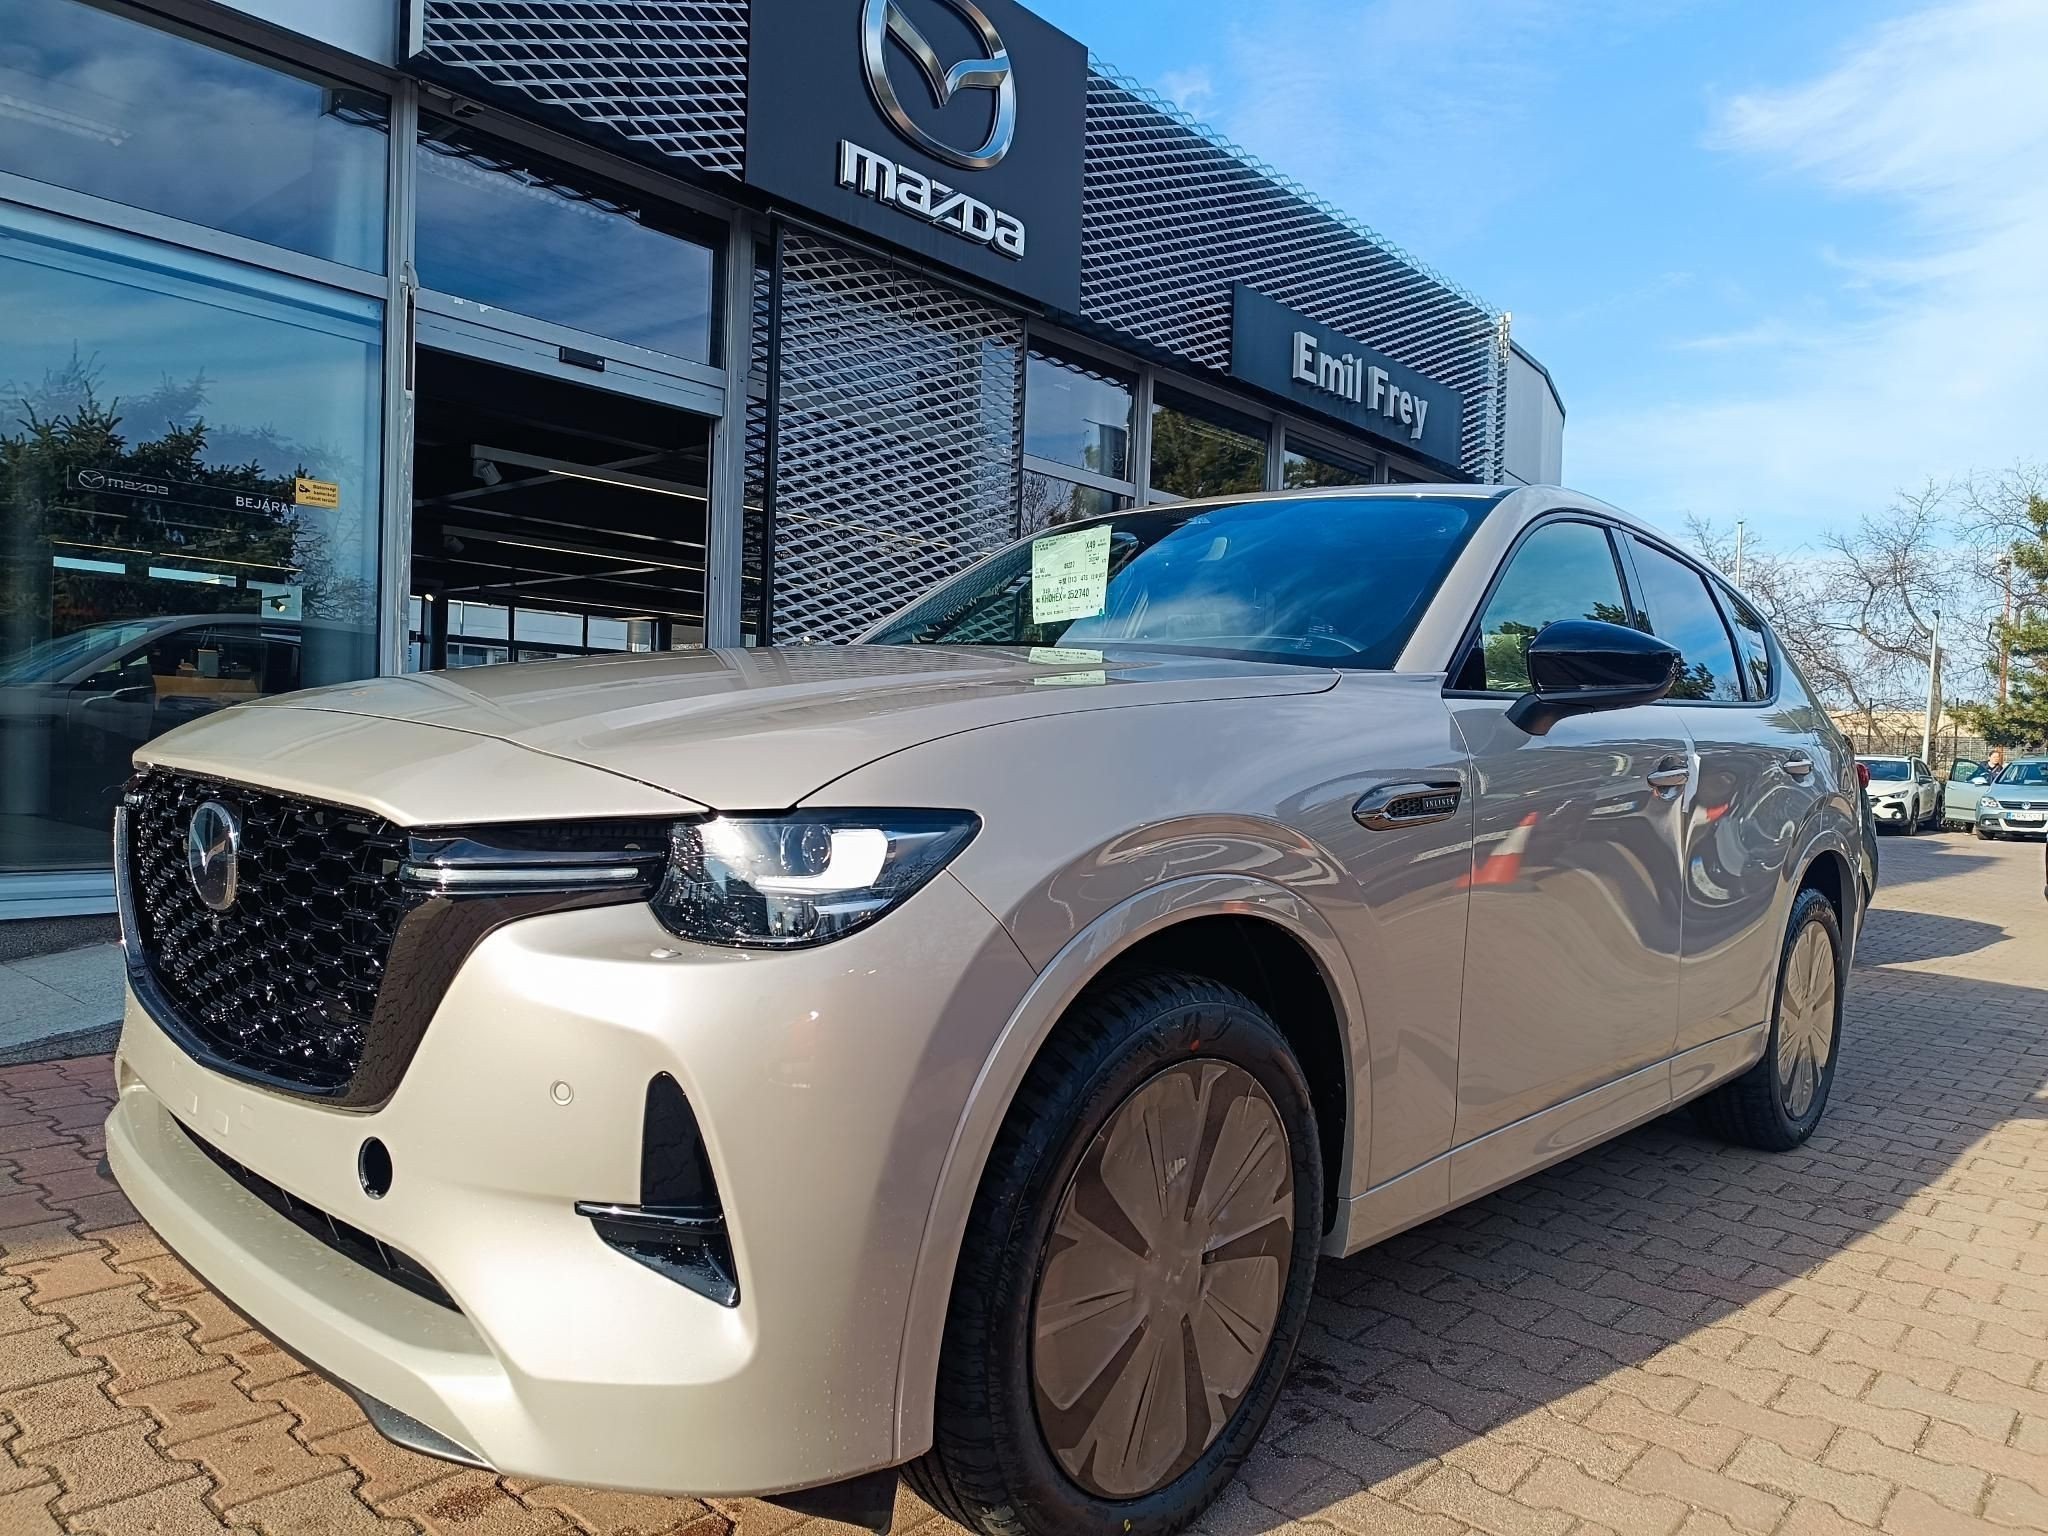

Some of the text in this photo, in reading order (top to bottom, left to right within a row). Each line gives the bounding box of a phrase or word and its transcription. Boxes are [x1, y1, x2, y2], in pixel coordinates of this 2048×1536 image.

[840, 139, 1026, 262] mazda
[1293, 331, 1428, 439] Emil Frey
[107, 478, 169, 496] mazda
[235, 496, 298, 514] BEJÁRAT
